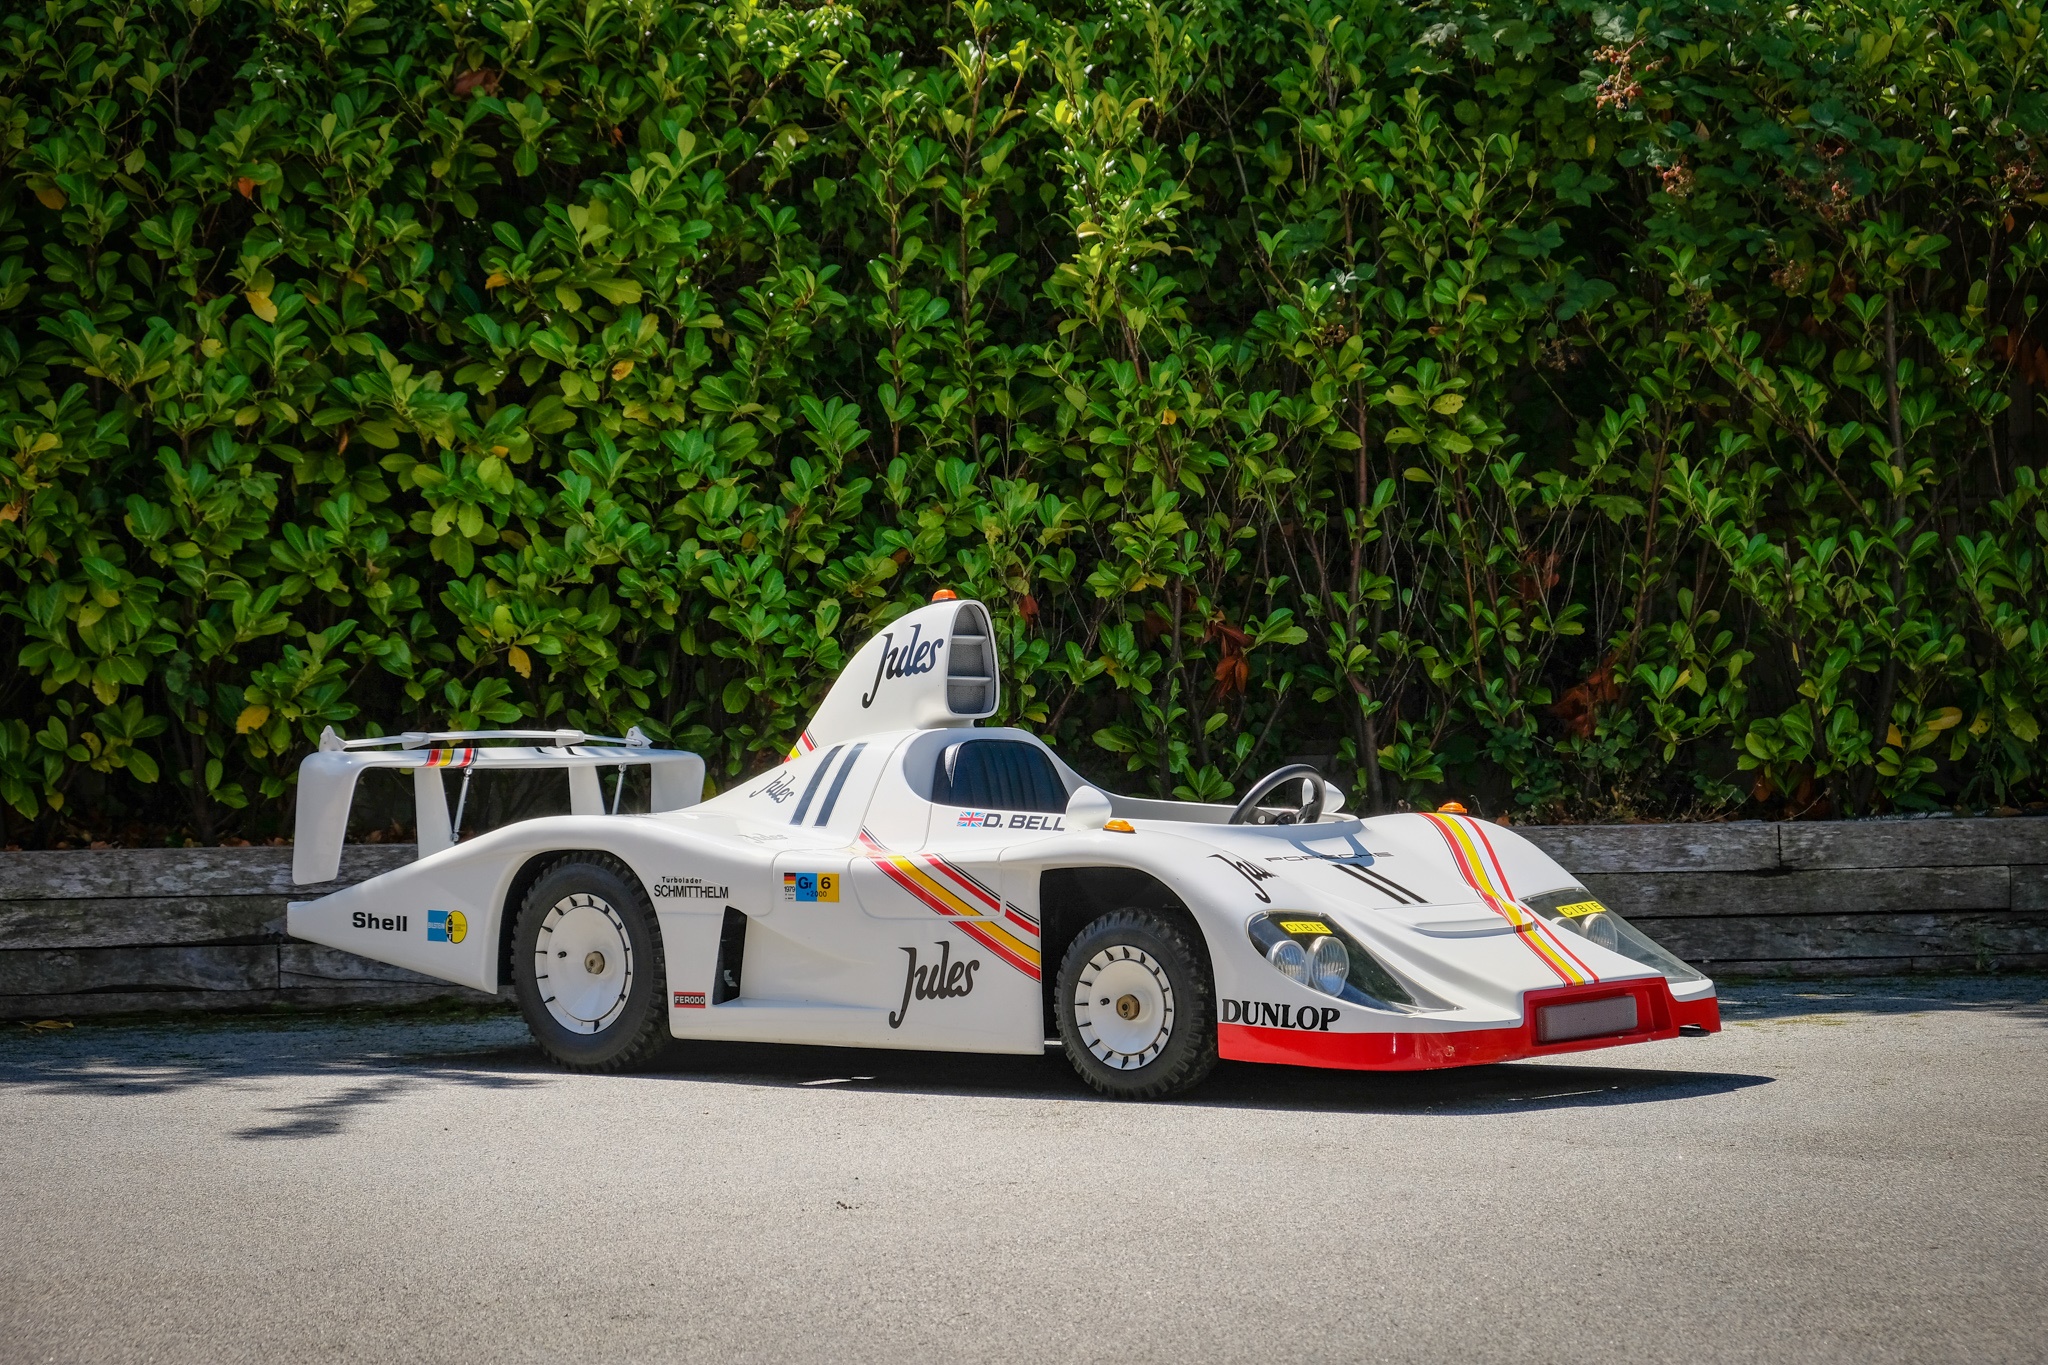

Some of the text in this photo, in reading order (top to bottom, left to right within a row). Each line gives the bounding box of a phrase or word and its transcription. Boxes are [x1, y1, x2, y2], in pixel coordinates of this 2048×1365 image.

[861, 623, 944, 709] Jules
[749, 770, 796, 804] Jules
[982, 813, 1066, 832] D. BELL
[661, 876, 702, 884] Turbolader
[798, 876, 832, 890] Gr 6
[654, 884, 729, 899] SCHMITTHELM
[1561, 902, 1603, 916] CIBIE
[352, 911, 408, 932] Shell
[889, 940, 980, 1029] Jules
[674, 996, 706, 1005] FERODO
[1221, 999, 1341, 1031] DUNLOP
